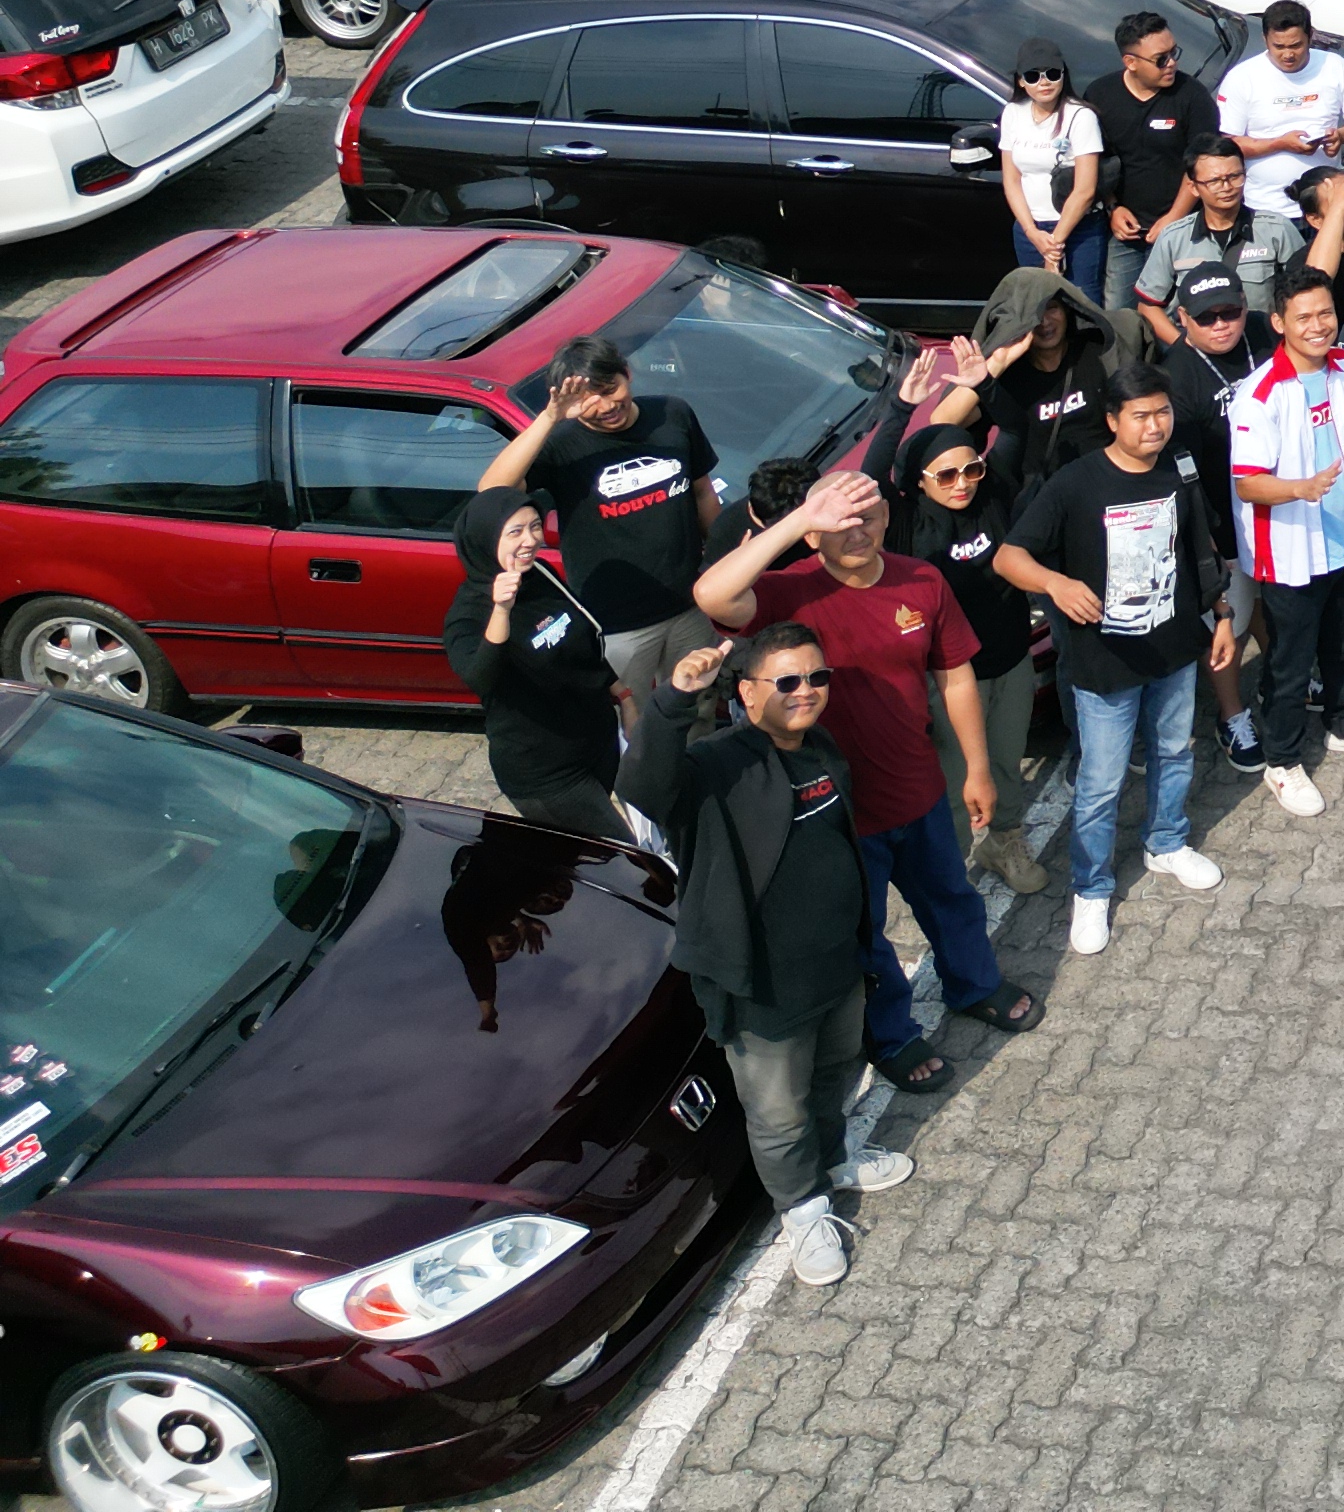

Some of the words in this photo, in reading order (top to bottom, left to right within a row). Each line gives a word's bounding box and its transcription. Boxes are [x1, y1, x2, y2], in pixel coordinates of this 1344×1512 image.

[150, 39, 163, 56] H
[166, 21, 195, 47] 1628
[202, 10, 220, 28] PK
[1241, 248, 1268, 259] HNCI
[1190, 277, 1230, 294] adidas
[598, 489, 668, 519] Nouva
[950, 532, 991, 560] HNCI
